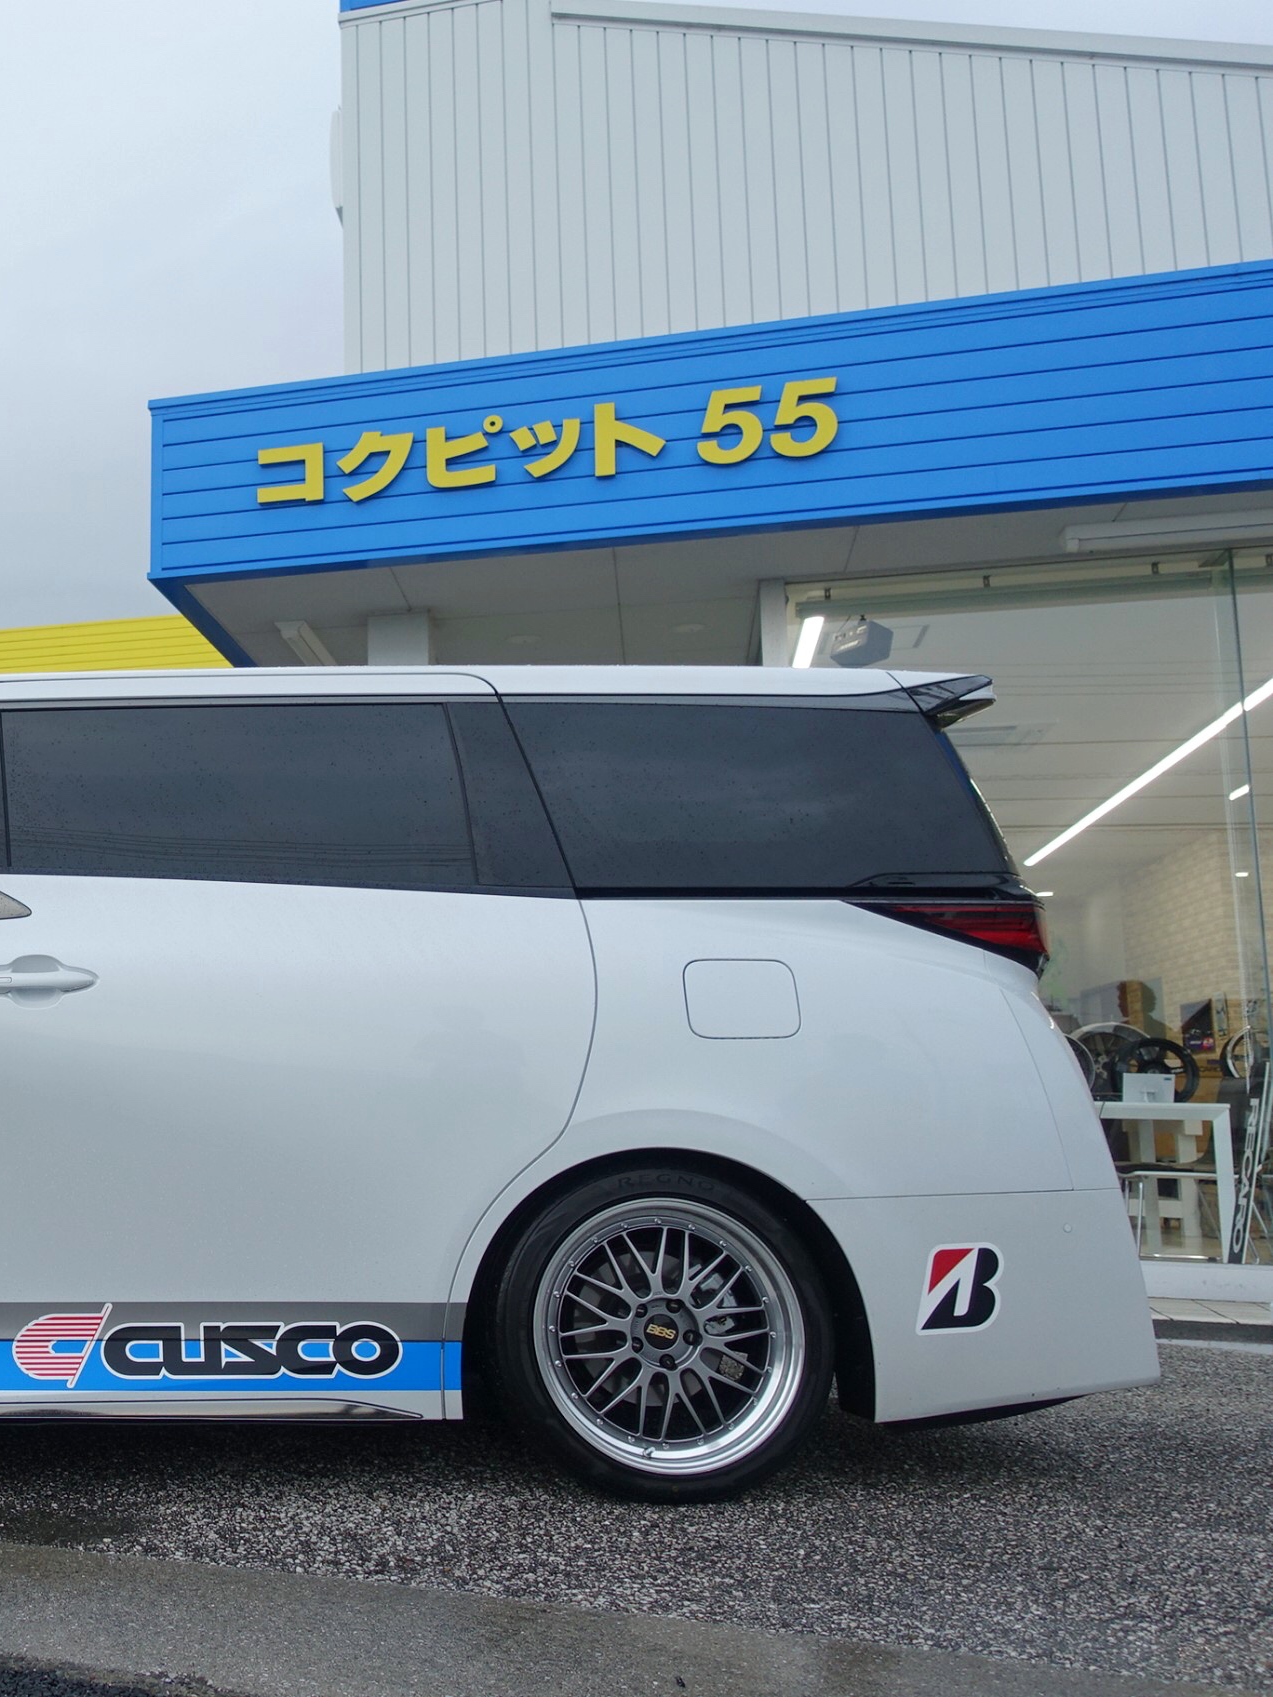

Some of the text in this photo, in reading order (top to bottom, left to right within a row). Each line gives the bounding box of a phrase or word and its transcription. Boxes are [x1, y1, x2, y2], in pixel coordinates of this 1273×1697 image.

[256, 376, 839, 504] コクピット 55
[1232, 1098, 1259, 1253] RECARO
[103, 1323, 400, 1376] CUSCO
[646, 1323, 677, 1340] BBS
